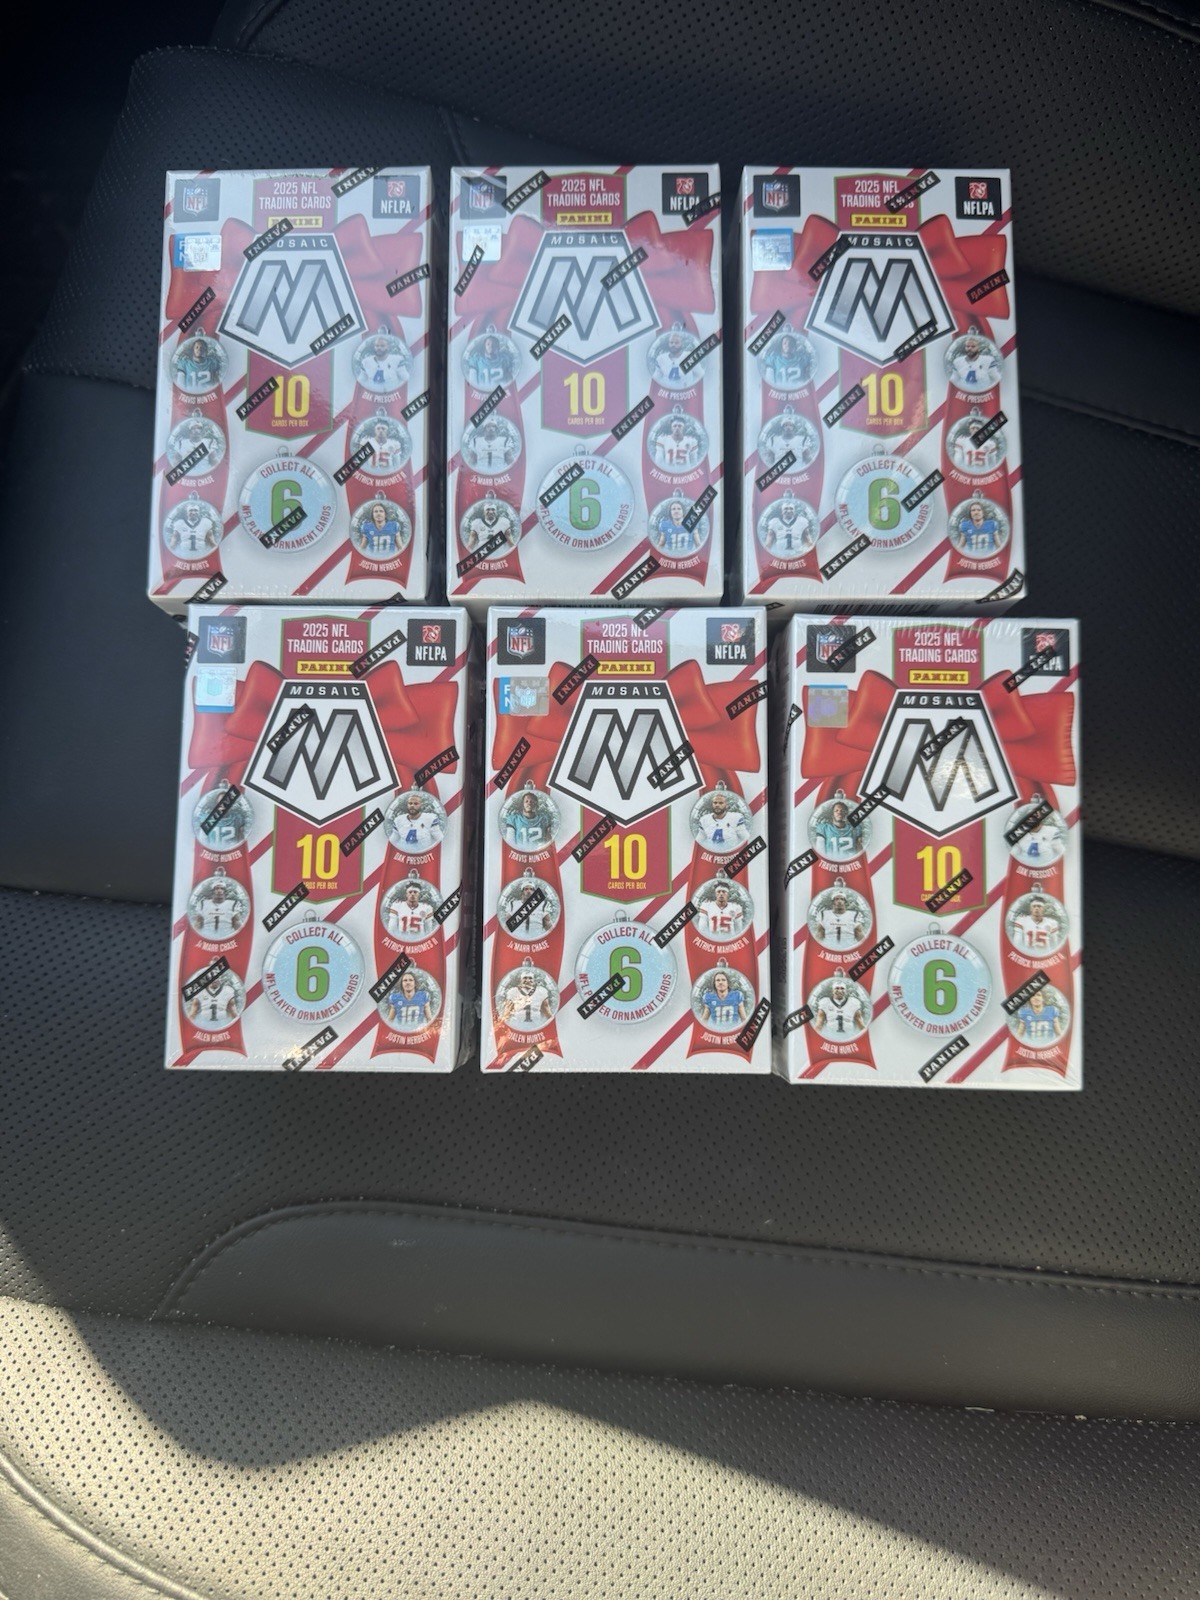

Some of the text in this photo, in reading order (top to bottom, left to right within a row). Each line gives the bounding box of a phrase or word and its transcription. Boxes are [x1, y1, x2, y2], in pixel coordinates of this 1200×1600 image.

[259, 196, 331, 209] TRADING CARDS
[274, 182, 317, 195] 2025 NFL
[506, 175, 545, 210] PANINI
[547, 193, 620, 207] TRADING CARDS
[561, 179, 606, 192] 2025 NFL
[841, 194, 880, 208] TRADING
[855, 181, 899, 193] 2025 NFL
[381, 200, 411, 214] NFLPA
[560, 215, 609, 223] PANINI
[964, 201, 994, 215] NFLPA
[248, 223, 288, 257] PANINI
[551, 235, 619, 244] MOSAIC
[848, 237, 913, 247] MOSAIC
[391, 267, 428, 292] PANINI
[458, 251, 481, 293] PANINI
[606, 252, 644, 287] PANINI
[315, 319, 351, 350] PANINI
[534, 318, 568, 355] PANINI
[752, 314, 781, 351] PANINI
[684, 339, 715, 370] PANINI
[240, 383, 275, 414] PANINI
[273, 374, 310, 418] 10
[564, 372, 605, 415] 10
[827, 389, 862, 422] PANINI
[861, 372, 904, 415] 10
[616, 400, 650, 436] PANINI
[170, 449, 204, 480] PANINI
[261, 461, 315, 479] COLLECT ALL
[597, 463, 613, 477] ALL
[759, 456, 793, 486] PANINI
[857, 460, 912, 478] COLLECT ALL
[543, 469, 580, 503] PANINI
[906, 475, 942, 507] PANINI
[242, 505, 252, 520] NFL
[316, 506, 331, 532] CARDS
[272, 479, 302, 531] 6
[569, 478, 601, 531] 6
[686, 490, 714, 528] PANINI
[868, 478, 901, 530] 6
[545, 520, 571, 545] PLAYER
[572, 529, 615, 548] ORNAMENT
[614, 504, 629, 530] CARDS
[840, 503, 849, 518] NFL
[871, 529, 916, 548] ORNAMENT
[914, 504, 929, 530] CARDS
[825, 540, 866, 574] PANINI
[616, 561, 656, 596] PANINI
[288, 639, 363, 654] TRADING CARDS
[303, 624, 349, 638] 2025 NFL
[588, 640, 663, 654] TRADING CARDS
[602, 624, 628, 637] 2025
[915, 632, 962, 646] 2025 NFL
[355, 636, 400, 674] PANINI
[415, 646, 446, 661] NFLPA
[601, 664, 652, 672] PANINI
[715, 645, 746, 660] NFLPA
[900, 648, 977, 663] TRADING CARDS
[290, 686, 361, 696] MOSAIC
[558, 660, 595, 698] PANINI
[592, 686, 661, 696] MOSAIC
[913, 672, 966, 682] PANINI
[903, 696, 976, 706] MOSAIC
[420, 752, 455, 781] PANINI
[499, 743, 526, 782] PANINI
[344, 815, 380, 850] PANINI
[576, 820, 613, 856] PANINI
[297, 834, 340, 880] 10
[604, 834, 647, 880] 10
[917, 846, 962, 891] 10
[266, 888, 306, 926] PANINI
[286, 926, 344, 945] COLLECT ALL
[597, 926, 654, 945] COLLECT ALL
[659, 908, 693, 942] PANINI
[852, 941, 891, 977] PANINI
[911, 940, 970, 959] COLLECT ALL
[186, 963, 225, 998] PANINI
[296, 946, 330, 1002] 6
[610, 946, 642, 1002] 6
[923, 959, 957, 1015] 6
[266, 973, 358, 1020] NFL PLAYER ORNAMENT CARDS
[579, 973, 589, 989] NFL
[612, 1001, 658, 1020] ORNAMENT
[656, 974, 671, 1002] CARDS
[582, 980, 620, 1014] PANINI
[892, 986, 987, 1034] NFL PLAYER ORNAMENT CARDS
[1007, 976, 1046, 1010] PANINI
[741, 1003, 769, 1046] PANINI
[923, 1040, 964, 1078] PANINI
